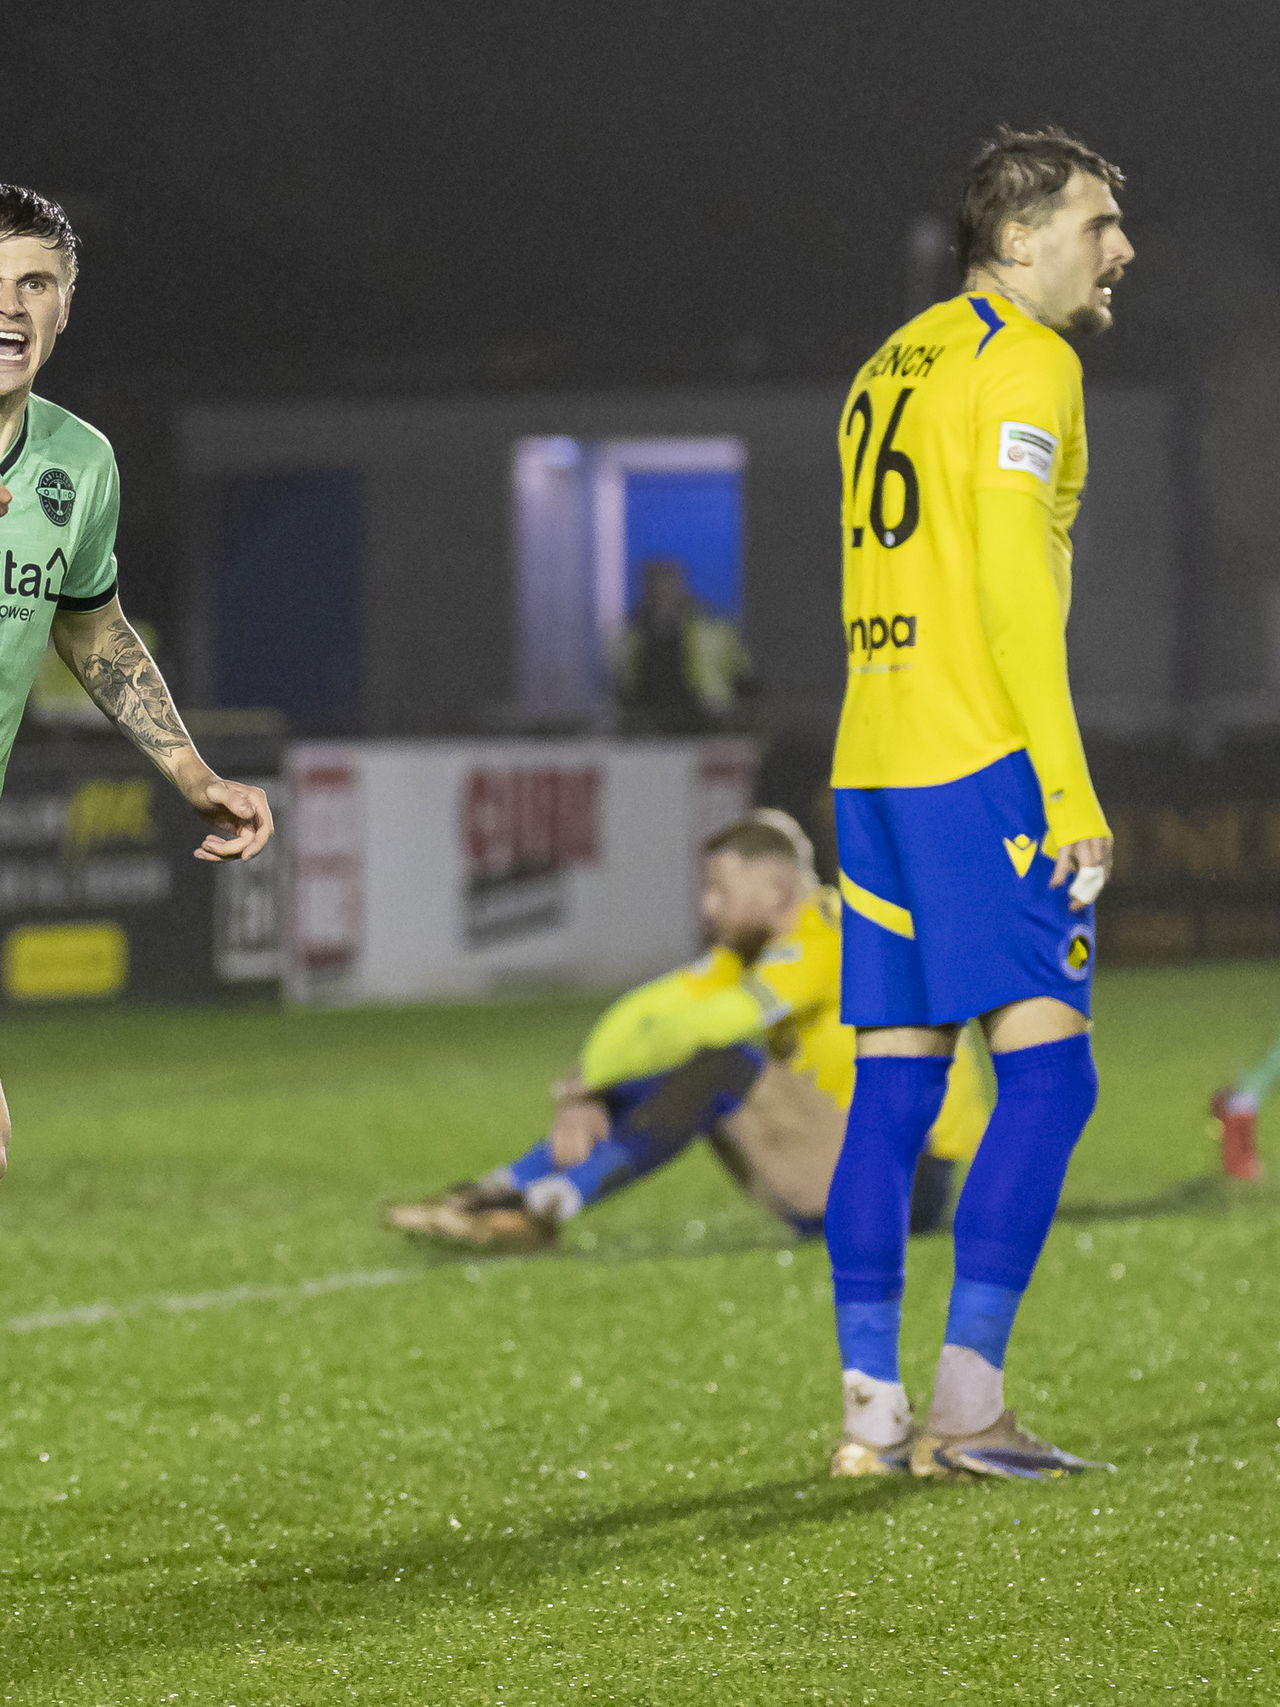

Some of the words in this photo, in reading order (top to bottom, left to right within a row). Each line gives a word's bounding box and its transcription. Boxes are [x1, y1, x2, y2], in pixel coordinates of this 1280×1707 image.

[869, 344, 946, 377] ENCH
[846, 387, 920, 548] 26
[849, 615, 917, 661] npa
